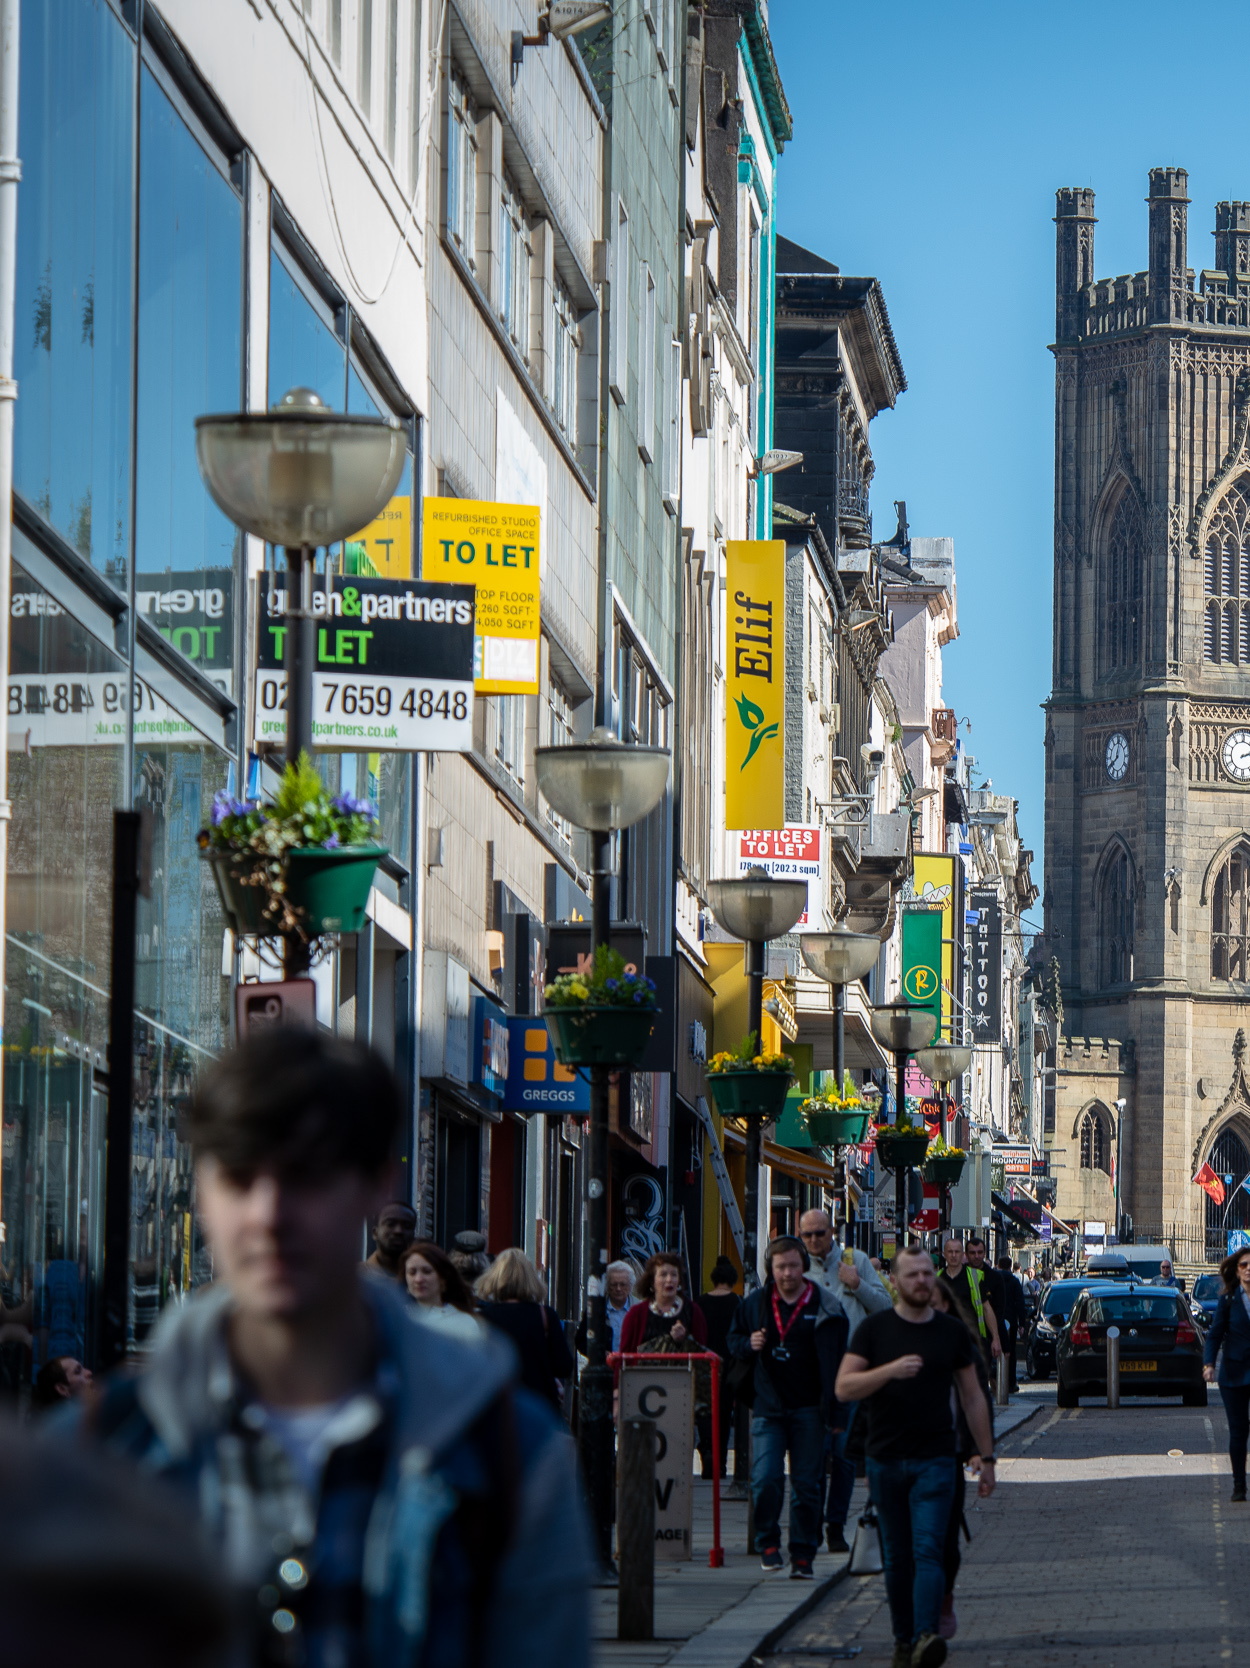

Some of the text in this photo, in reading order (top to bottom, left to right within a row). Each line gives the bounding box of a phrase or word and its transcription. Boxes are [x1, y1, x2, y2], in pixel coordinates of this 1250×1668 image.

[432, 511, 536, 527] REFURBISHED STUDIO
[468, 526, 535, 540] OFFICE SPACE
[439, 539, 535, 569] TO LET
[475, 589, 534, 603] TOP FLOOR
[266, 586, 473, 625] gen&partners
[506, 619, 534, 630] SQFT
[734, 590, 773, 684] Elif
[318, 628, 374, 665] LET
[321, 682, 393, 718] 7659
[399, 687, 468, 721] 4848
[740, 830, 813, 844] OFFICES
[746, 841, 806, 857] TO LET
[977, 907, 989, 1007] TATTOO
[522, 1089, 576, 1102] GREGGS
[1002, 1150, 1030, 1158] brigham
